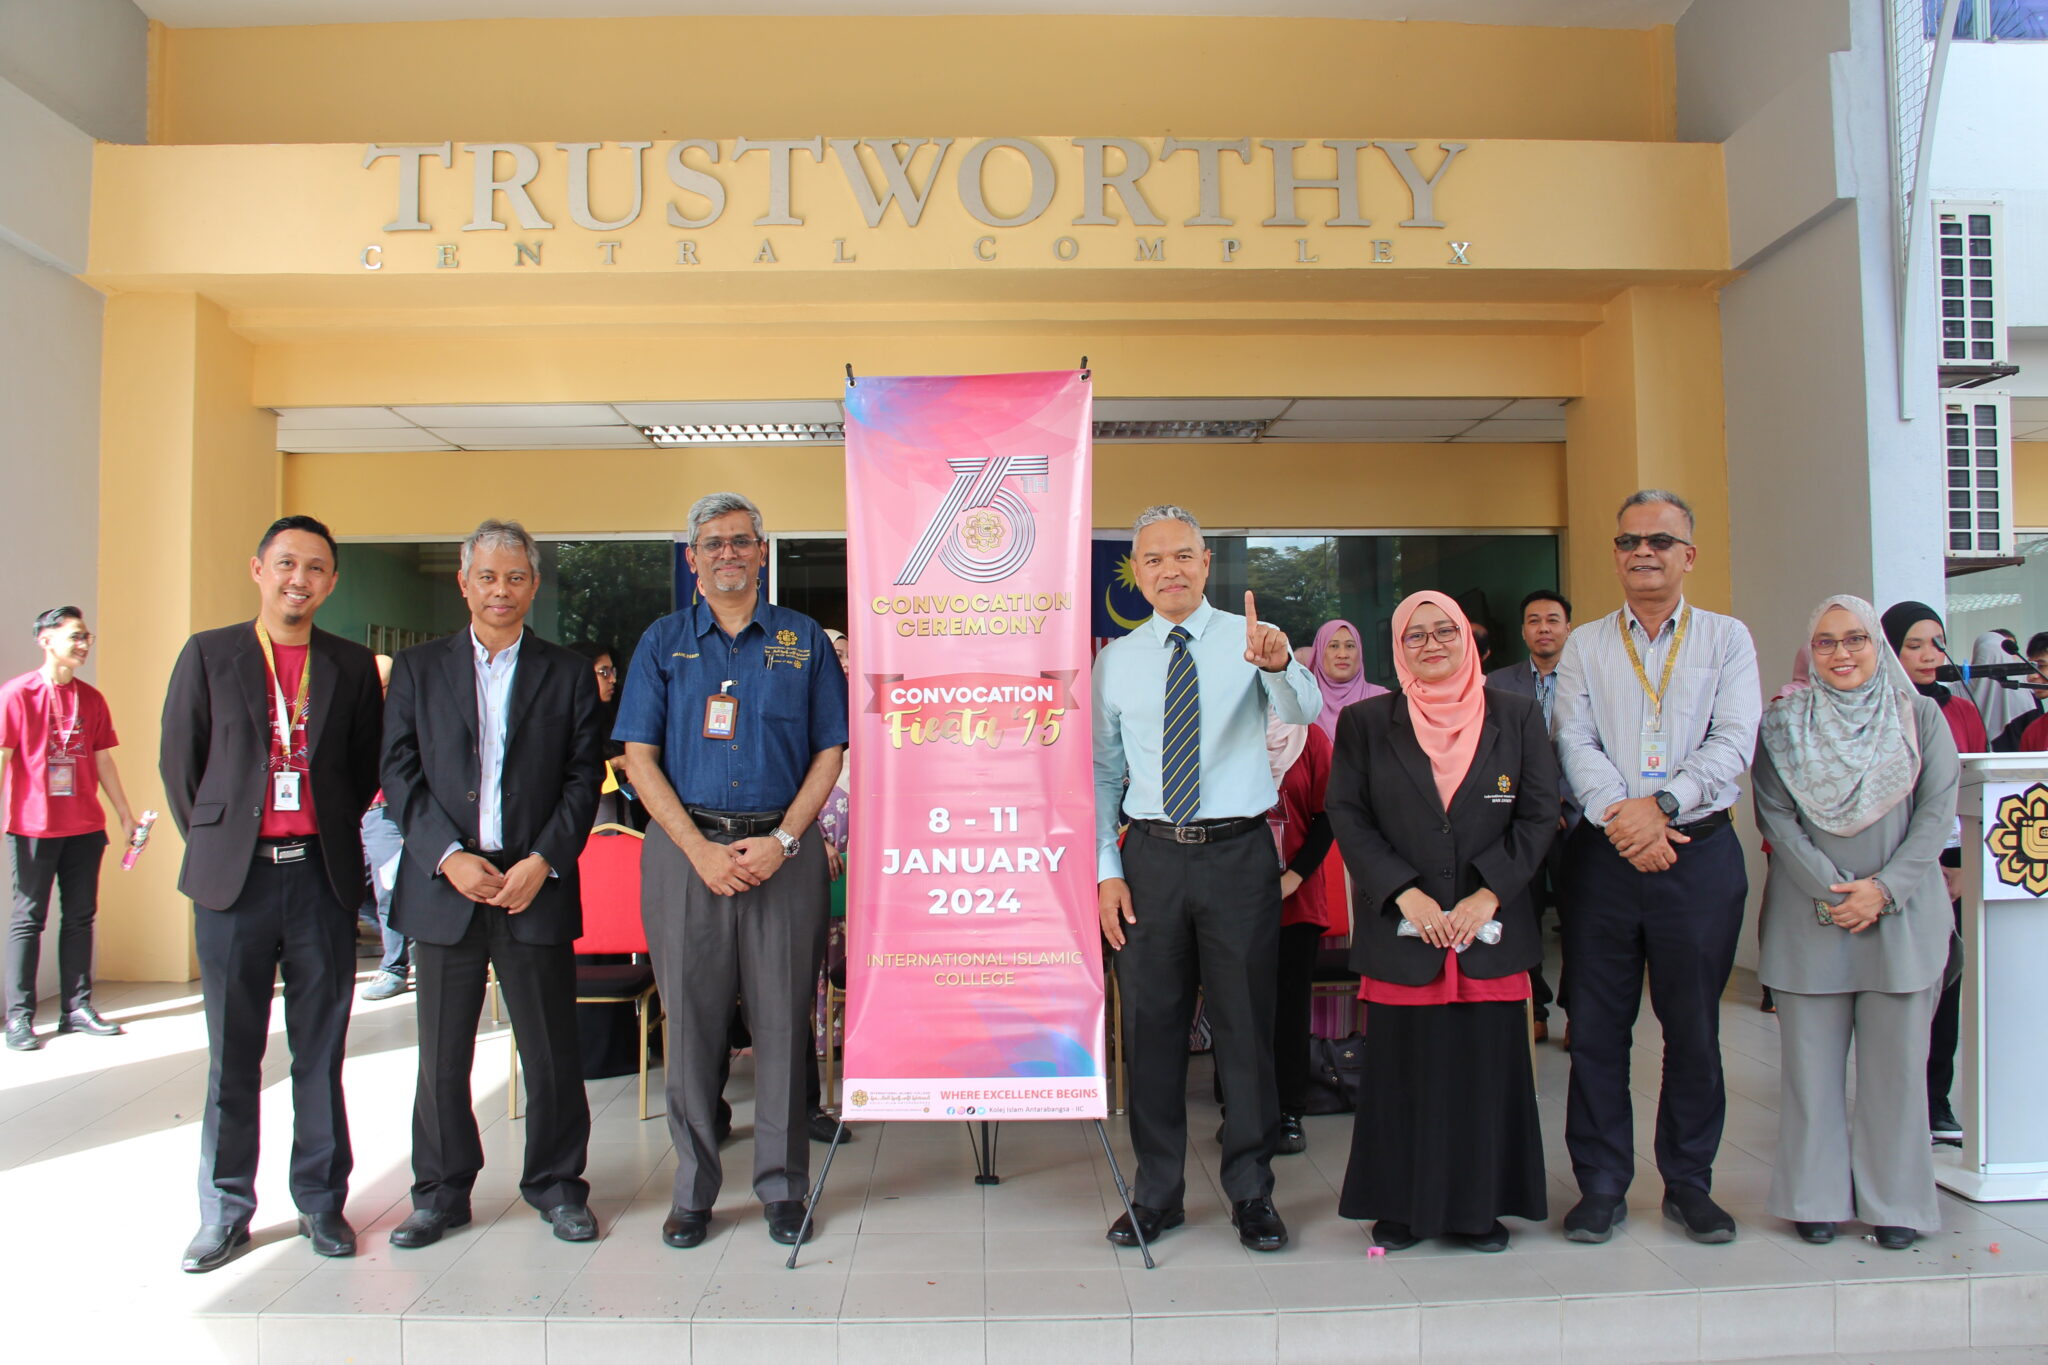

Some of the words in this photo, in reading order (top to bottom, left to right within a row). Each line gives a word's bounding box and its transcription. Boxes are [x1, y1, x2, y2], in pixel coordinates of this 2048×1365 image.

[362, 135, 1467, 231] TRUSTWORTHY
[360, 239, 856, 270] CENTRAL
[973, 236, 1472, 266] COMPLEX
[872, 592, 1072, 614] CONVOCATION
[896, 616, 1046, 637] CEREMONY
[890, 685, 1053, 704] CONVOCATION
[884, 705, 1005, 749] Fiesta
[928, 807, 950, 833] 8
[989, 807, 1019, 832] 11
[882, 846, 1066, 874] JANUARY
[928, 888, 1021, 915] 2024
[867, 953, 1008, 967] INTERNATIONAL
[1012, 951, 1082, 966] ISLAMIC
[934, 972, 1015, 986] COLLEGE
[940, 1090, 980, 1099] WHERE
[983, 1090, 1053, 1099] EXCELLENCE
[1057, 1089, 1098, 1098] BEGINS
